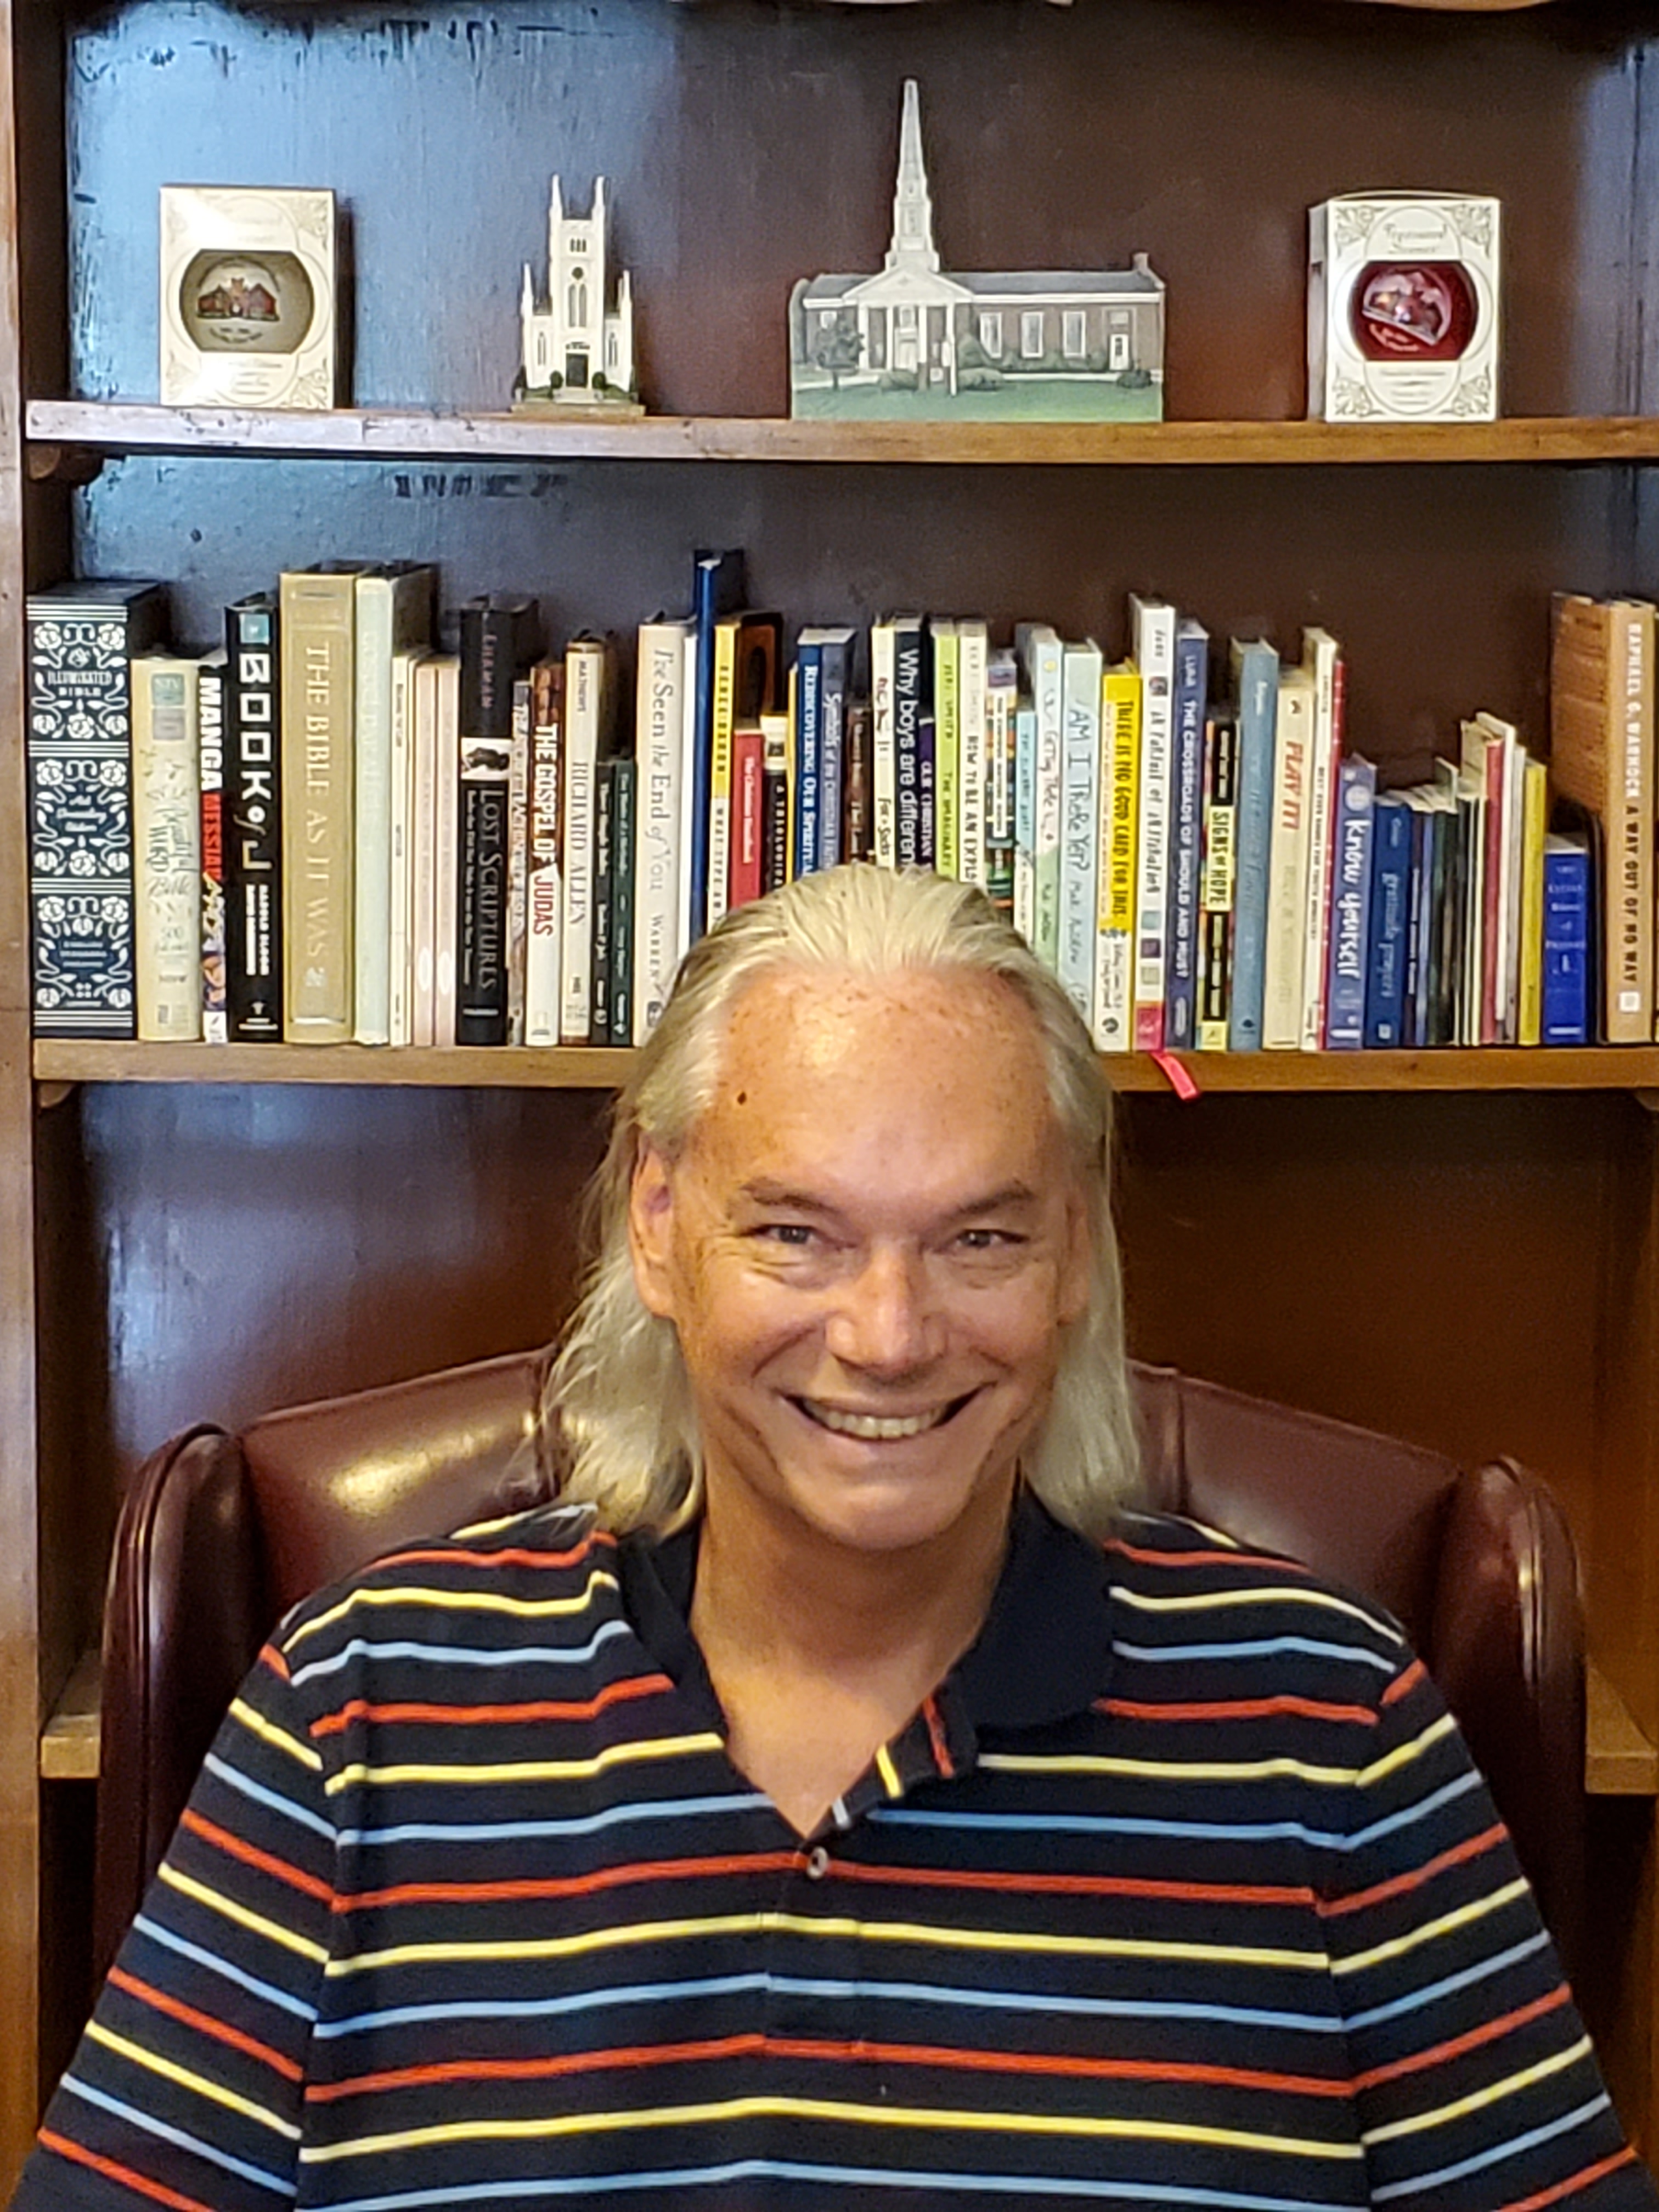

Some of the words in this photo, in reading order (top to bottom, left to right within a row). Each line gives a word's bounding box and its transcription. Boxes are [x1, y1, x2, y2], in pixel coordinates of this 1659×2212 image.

[305, 642, 331, 706] THE
[653, 649, 675, 680] I've
[896, 648, 919, 695] Why
[1627, 623, 1643, 696] RAPHAEL
[58, 687, 101, 696] BIBLE
[652, 683, 674, 737] Seen
[239, 653, 272, 800] BOOK
[804, 665, 819, 773] REDISCOVERING
[822, 692, 842, 747] Symbols
[896, 700, 917, 748] boys
[1068, 709, 1091, 741] AM
[1114, 701, 1135, 738] THERE
[1183, 701, 1196, 727] THE
[200, 677, 223, 792] MANGA
[533, 723, 557, 760] THE
[1114, 744, 1133, 756] IS
[305, 714, 331, 797] BIBLE
[651, 745, 670, 767] the
[899, 754, 915, 786] are
[1068, 753, 1091, 770] I
[1114, 760, 1133, 781] NO
[1284, 741, 1304, 796] PLAY
[1626, 722, 1642, 798] WARNOCK
[776, 785, 786, 794] A
[803, 777, 817, 807] OUR
[920, 761, 932, 788] OUR
[1180, 730, 1196, 823] CROSSROADS
[533, 764, 557, 835] GOSPEL
[571, 761, 589, 851] RICHARD
[650, 774, 673, 819] End
[1113, 786, 1133, 821] GOOD
[1625, 805, 1639, 815] A
[306, 809, 330, 845] AS
[479, 790, 505, 845] LOST
[645, 826, 670, 843] of
[921, 795, 933, 857] CHRISTIAN
[964, 811, 978, 832] AN
[1180, 825, 1192, 845] OF
[1211, 812, 1229, 854] SIGNS
[242, 840, 273, 870] J
[533, 839, 556, 862] OF
[774, 801, 786, 887] THEOLOGICA
[802, 811, 816, 877] SPIRITUA
[1113, 825, 1132, 856] CARD
[1342, 819, 1373, 887] know
[1625, 821, 1639, 855] WAY
[306, 855, 330, 884] IT
[648, 849, 672, 892] You
[964, 838, 978, 881] EXPLO
[1112, 861, 1131, 883] FOR
[1177, 849, 1193, 905] SHOULD
[1624, 860, 1639, 890] OUT
[533, 875, 555, 935] JUDAS
[569, 864, 587, 926] ALLEN
[1209, 869, 1228, 904] HOPE
[478, 853, 504, 989] SCRIPTURES
[1176, 908, 1189, 938] AND
[1624, 897, 1639, 917] OF
[306, 897, 330, 958] WAS
[649, 915, 665, 977] WARREN
[1335, 893, 1363, 981] yourself
[1624, 923, 1639, 944] NO
[1175, 940, 1189, 978] MUST
[1623, 951, 1639, 983] WAY
